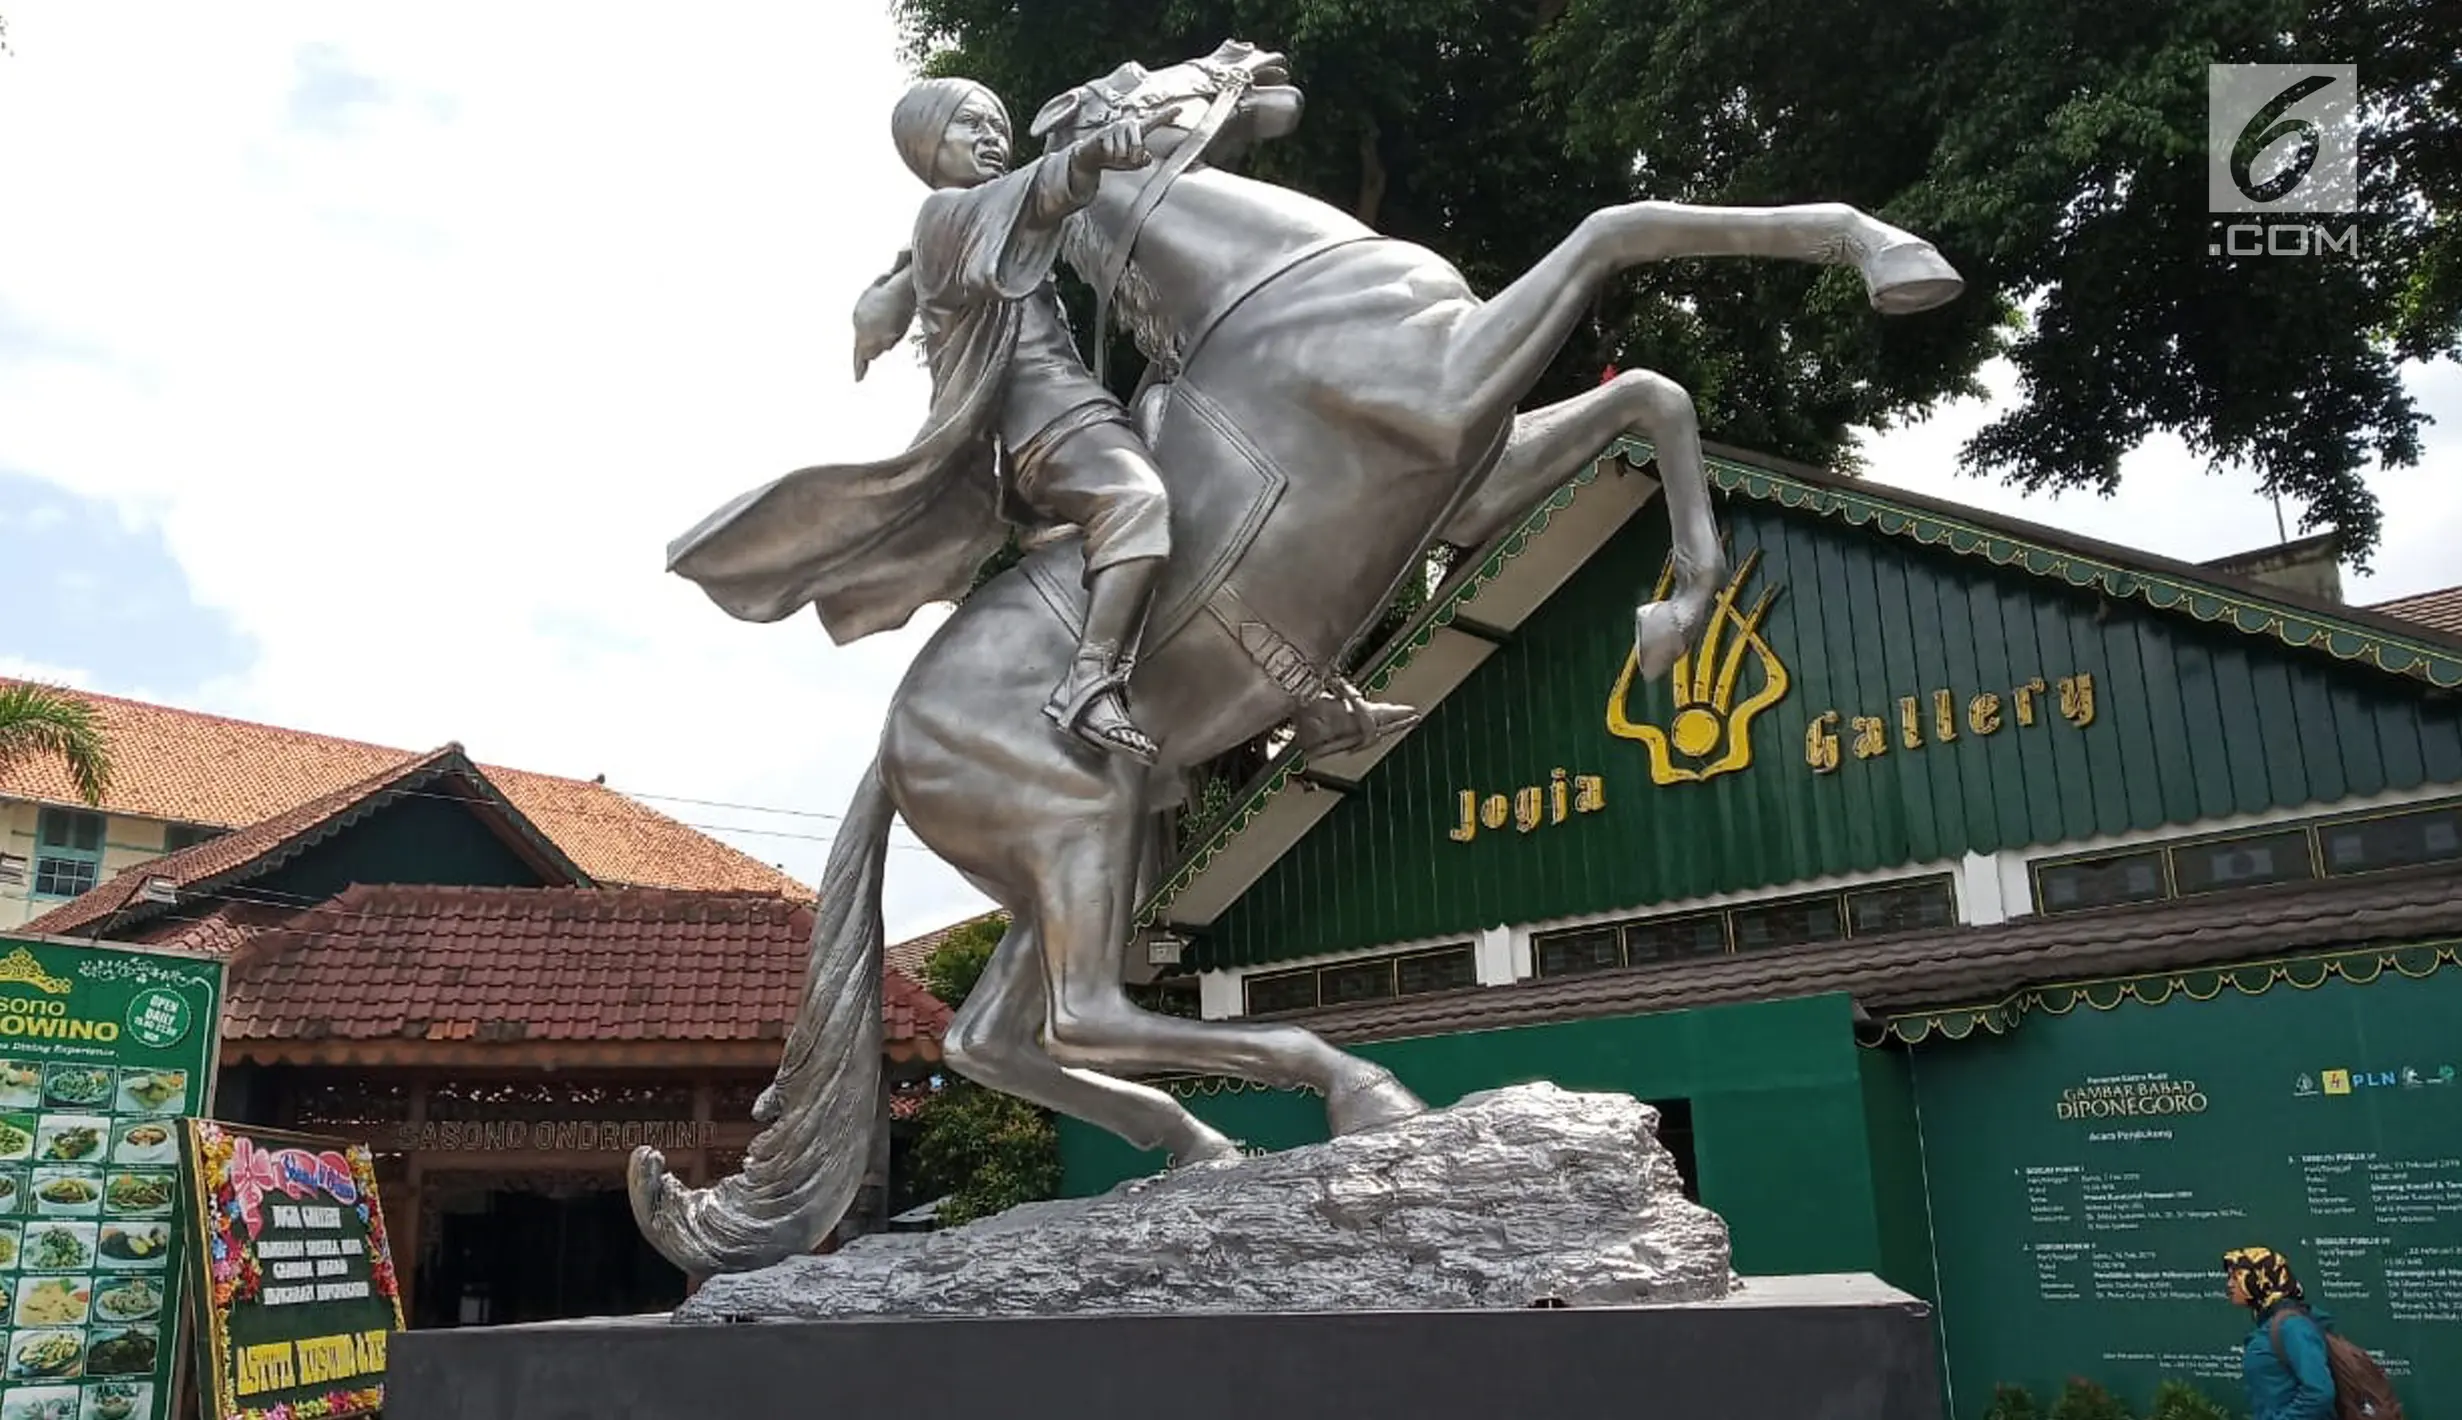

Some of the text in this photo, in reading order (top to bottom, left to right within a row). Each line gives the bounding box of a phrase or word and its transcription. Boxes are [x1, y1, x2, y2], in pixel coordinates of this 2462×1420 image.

[1450, 671, 2096, 842] Jogja Gallery
[2063, 1080, 2196, 1101] GAMBAR BABAD
[2352, 1071, 2396, 1087] PLN
[2057, 1092, 2208, 1120] DIPONEGORO
[397, 1118, 527, 1151] SASONO
